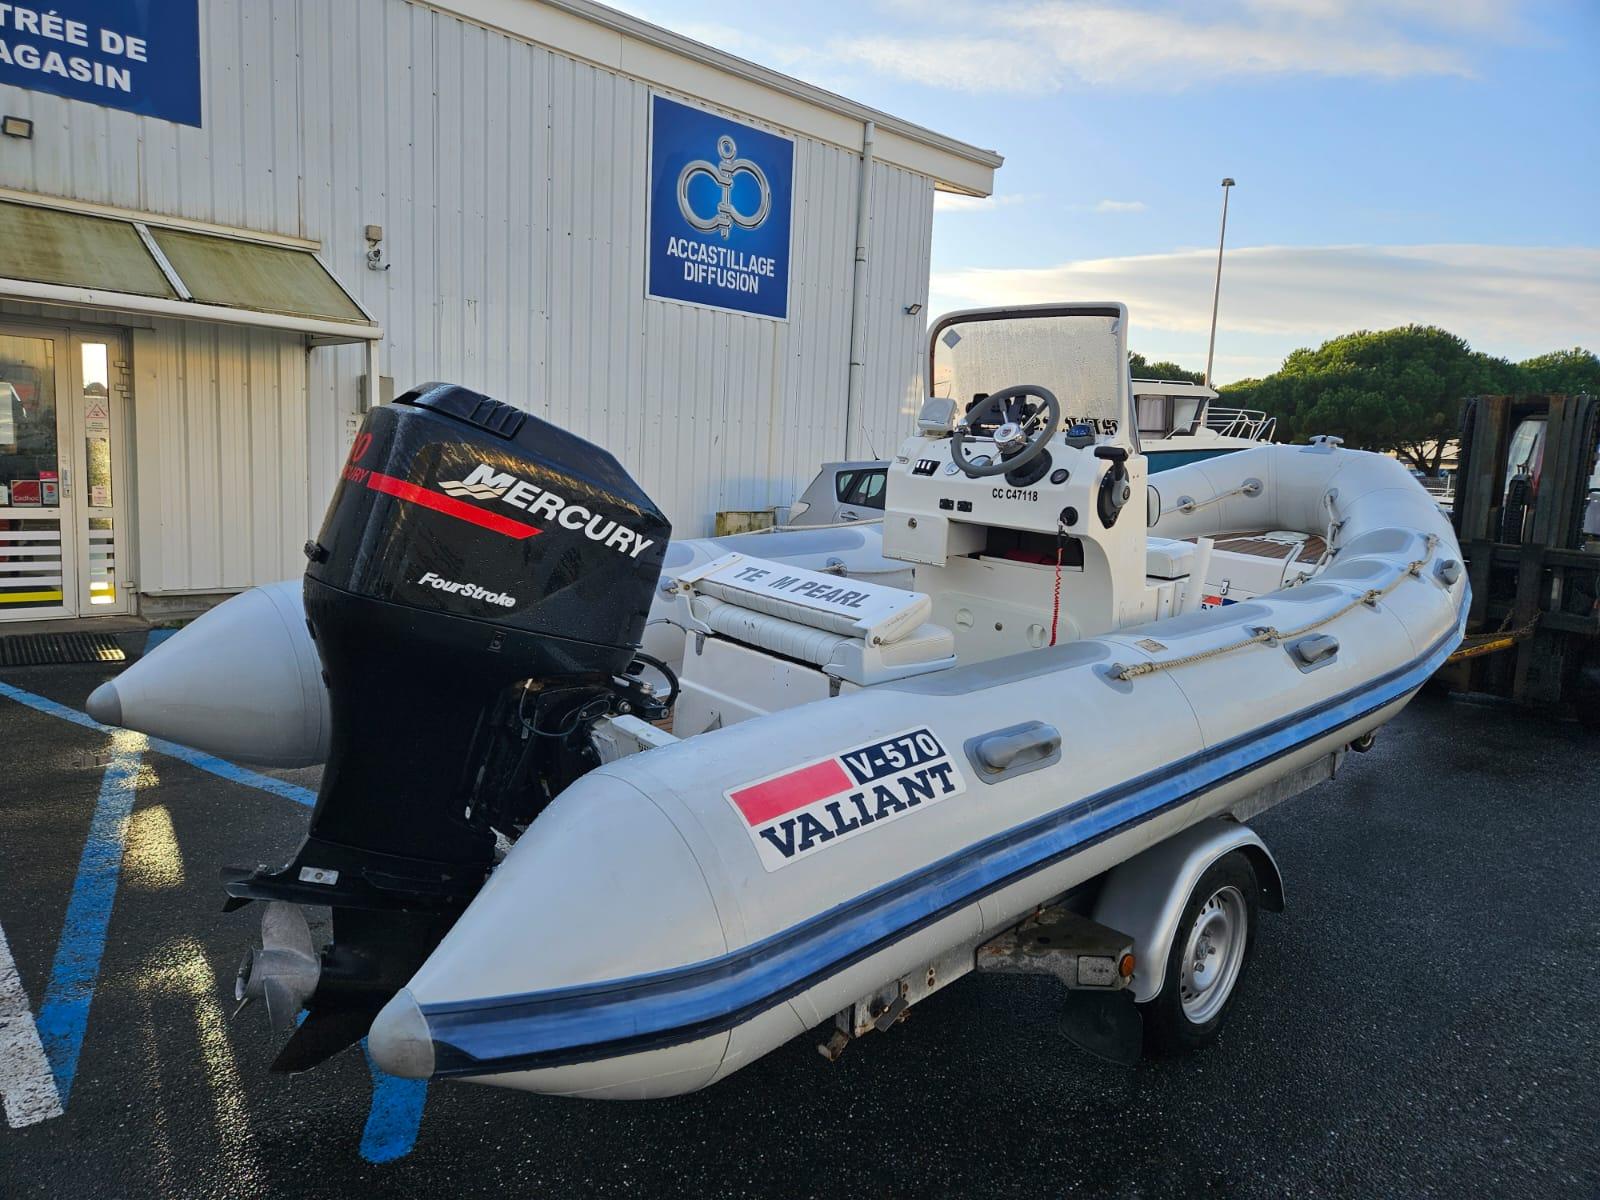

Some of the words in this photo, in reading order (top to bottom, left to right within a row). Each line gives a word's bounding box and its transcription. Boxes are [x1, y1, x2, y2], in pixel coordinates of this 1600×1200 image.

[100, 28, 148, 63] DE
[667, 236, 776, 278] ACCASTILLAGE
[684, 261, 759, 295] DIFFUSION
[461, 463, 655, 559] MERCURY
[991, 487, 1004, 499] CC
[1005, 489, 1038, 502] C47118
[418, 572, 516, 608] FourStroke
[789, 581, 871, 609] PEARL
[846, 732, 939, 779] V-570
[758, 762, 956, 859] VALIANT
